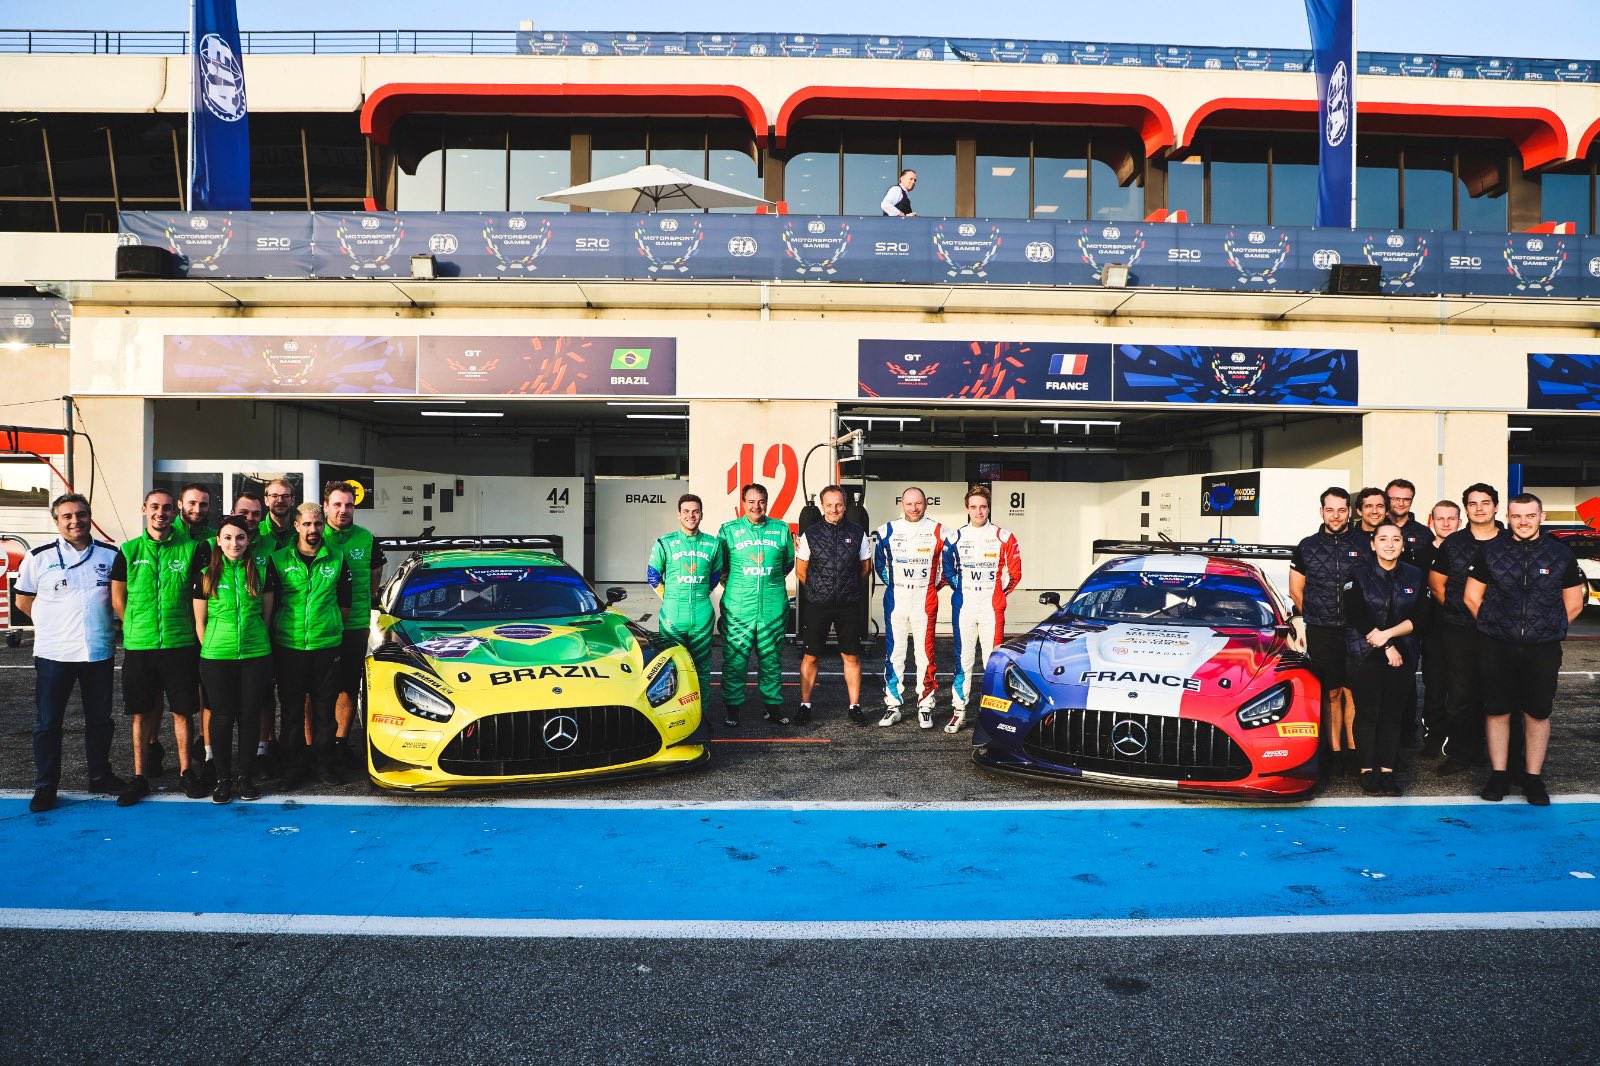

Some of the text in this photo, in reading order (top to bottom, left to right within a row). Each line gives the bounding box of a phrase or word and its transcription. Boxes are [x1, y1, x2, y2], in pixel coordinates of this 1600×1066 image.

[191, 218, 208, 228] FIA
[363, 218, 379, 228] FIA
[510, 219, 525, 228] FIA
[661, 220, 677, 230] FIA
[809, 223, 825, 232] FIA
[959, 226, 976, 235] FIA
[1104, 229, 1119, 238] FIA
[257, 238, 291, 246] SRO
[1249, 233, 1265, 242] FIA
[1388, 236, 1403, 246] FIA
[430, 236, 457, 251] FIA
[576, 239, 609, 247] SRO
[730, 239, 756, 254] FIA
[875, 242, 909, 251] SRO
[1528, 240, 1542, 250] FIA
[1027, 244, 1053, 259] FIA
[1169, 250, 1201, 258] SRO
[1450, 256, 1481, 266] SRO
[610, 376, 648, 385] BRAZIL
[1046, 381, 1089, 390] FRANCE
[546, 488, 569, 505] 44
[626, 494, 666, 503] BRAZIL
[895, 497, 940, 505] FCE
[1010, 492, 1025, 508] 81
[734, 539, 780, 550] BRASIL
[671, 550, 710, 562] BRASIL
[742, 566, 773, 576] VOLT
[676, 575, 705, 584] VOLT
[490, 666, 610, 686] BRAZIL
[1080, 671, 1199, 691] FRANCE
[372, 714, 406, 726] PIRELLI
[1281, 725, 1316, 735] PIRELLI
